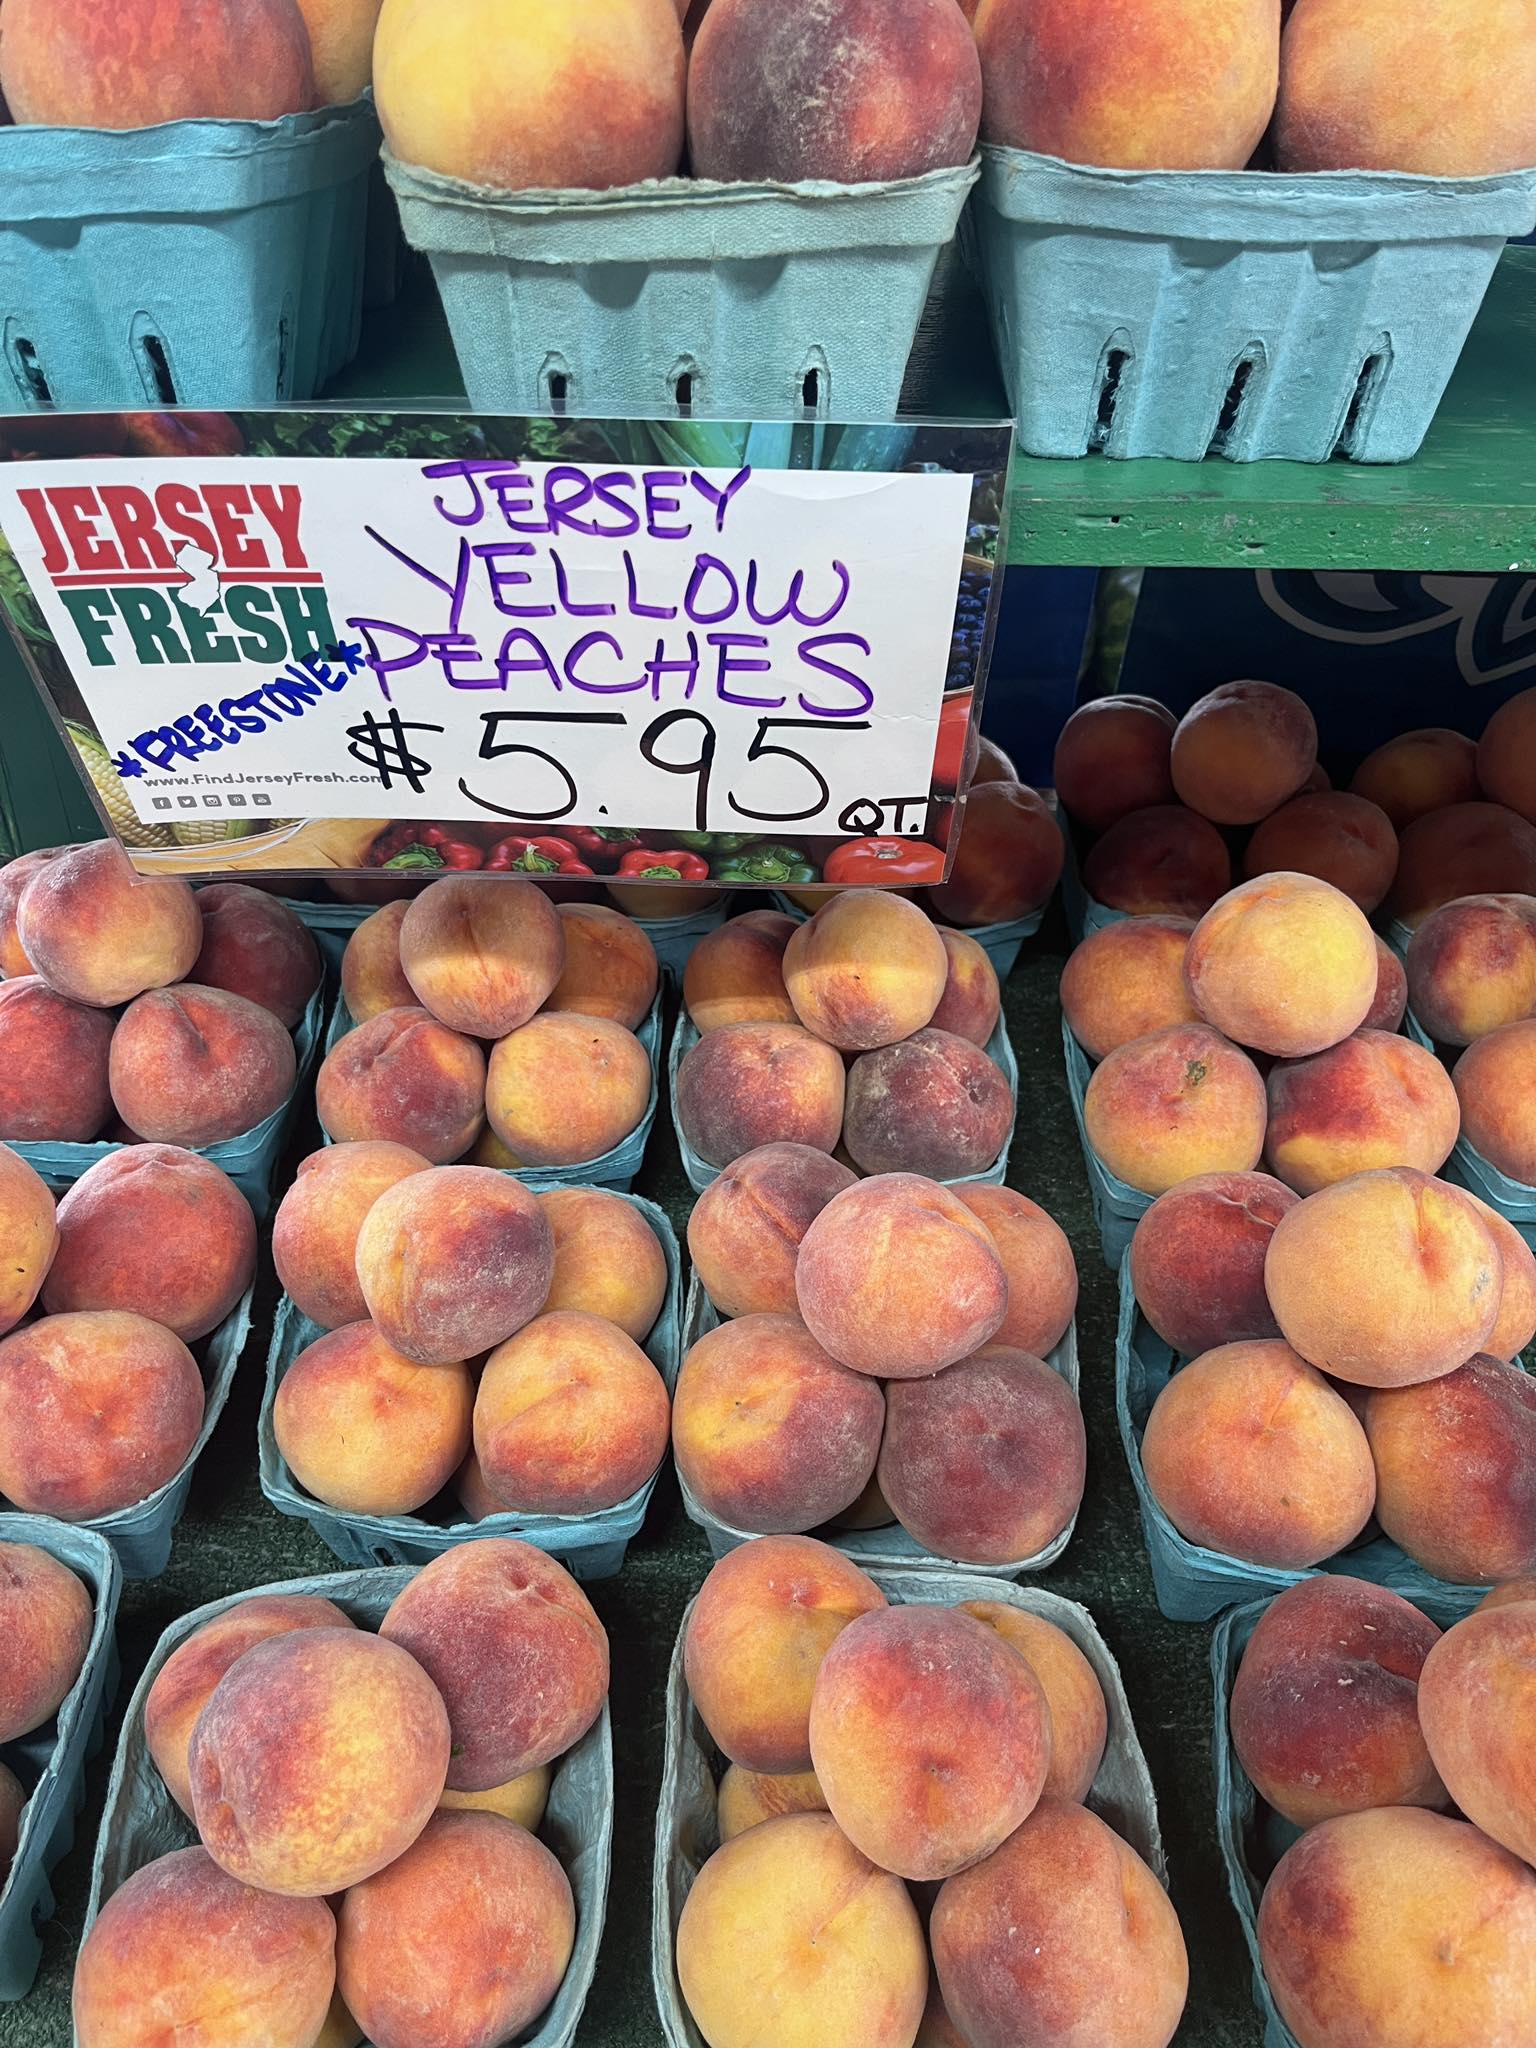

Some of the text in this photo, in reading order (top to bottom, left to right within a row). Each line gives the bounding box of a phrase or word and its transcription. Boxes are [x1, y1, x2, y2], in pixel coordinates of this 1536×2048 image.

[16, 483, 309, 572] JERSEY
[421, 460, 752, 537] JERSEY
[364, 525, 851, 634] YELLOW
[57, 584, 340, 666] FRESH
[346, 616, 872, 717] PEACHES
[837, 796, 928, 837] QT.
